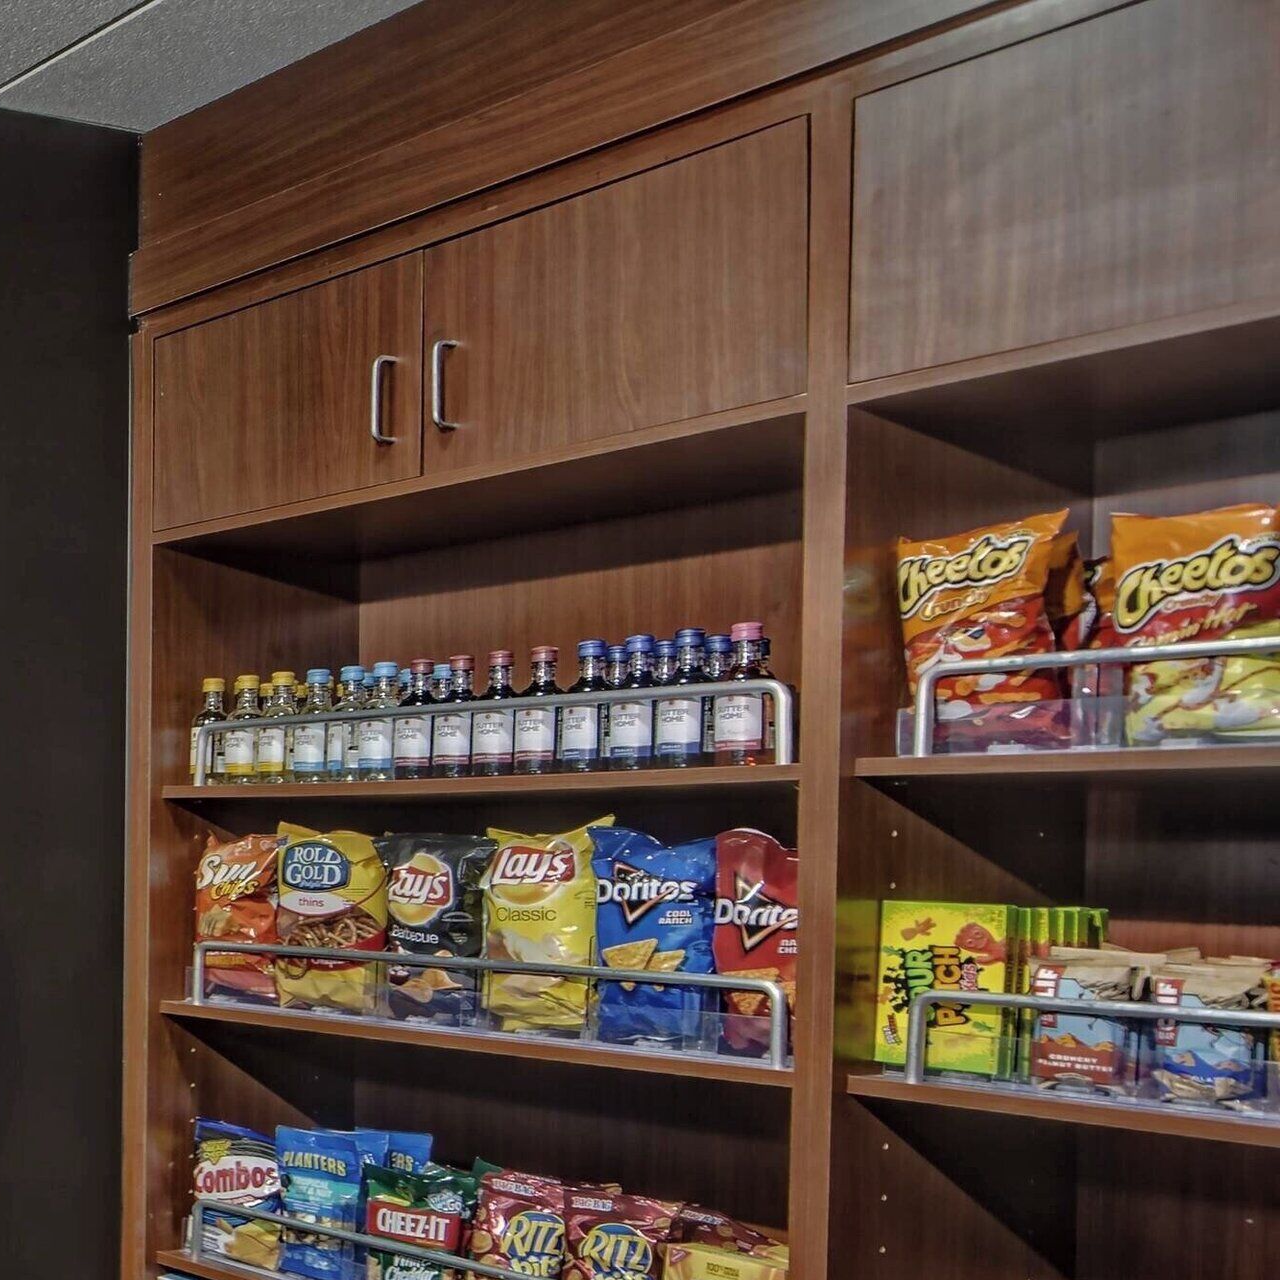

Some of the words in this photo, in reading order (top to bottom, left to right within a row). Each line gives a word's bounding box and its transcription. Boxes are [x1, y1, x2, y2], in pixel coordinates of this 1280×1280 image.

[899, 537, 1029, 614] Cheetos
[1117, 539, 1280, 629] Cheetos
[293, 846, 342, 864] ROLD
[492, 848, 575, 885] Lay's
[197, 854, 258, 890] Sun
[287, 864, 342, 885] GOLD
[298, 897, 325, 908] thins
[598, 879, 697, 904] Doritos
[496, 906, 557, 922] Classic
[658, 917, 692, 926] RANCH
[666, 910, 692, 918] COOL
[715, 898, 798, 930] Dorito
[392, 925, 439, 944] Barbecue
[194, 1161, 278, 1194] Combos
[283, 1151, 347, 1177] PLANTERS
[377, 1208, 451, 1241] CHEEZ-IT
[501, 1216, 566, 1257] RITZ
[580, 1230, 650, 1272] RITZ
